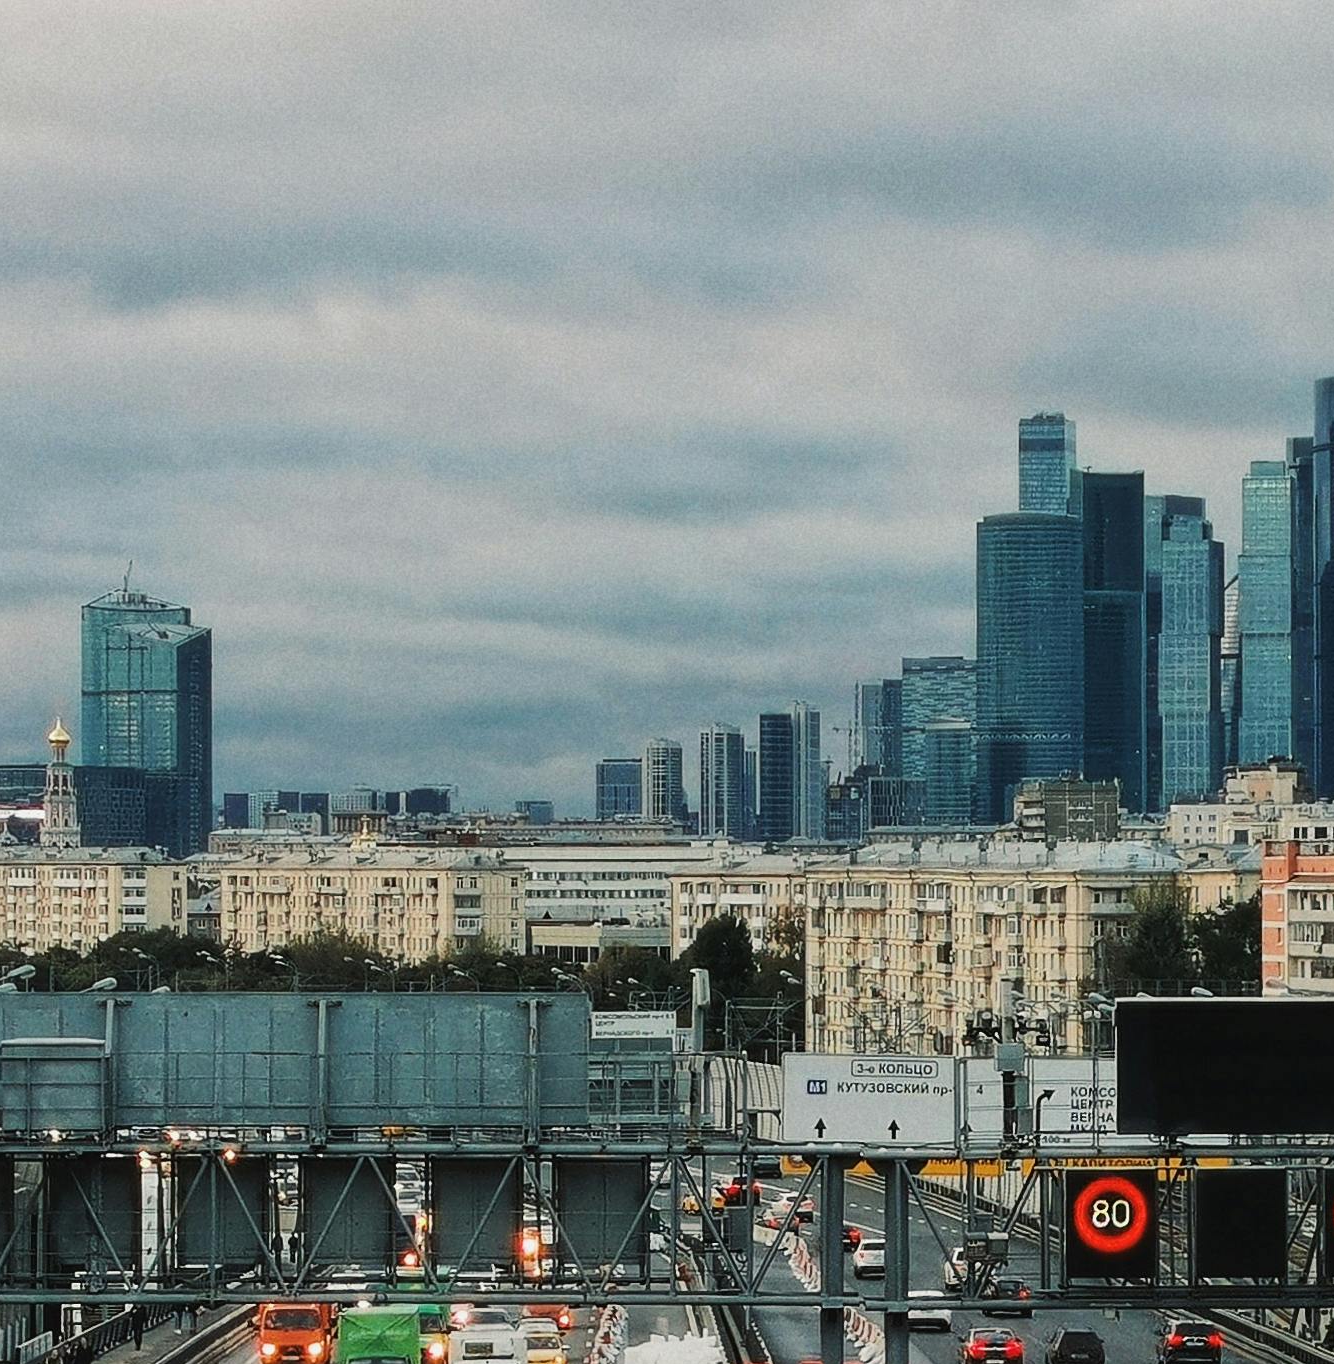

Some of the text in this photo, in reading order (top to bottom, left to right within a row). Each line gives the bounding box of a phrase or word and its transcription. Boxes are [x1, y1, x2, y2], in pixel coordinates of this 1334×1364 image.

[857, 1063, 933, 1077] 3-о КОЛЬЦО
[837, 1081, 930, 1093] КУТУЗОВСКИЙ
[932, 1086, 954, 1096] пр-
[1092, 1199, 1130, 1229] 80
